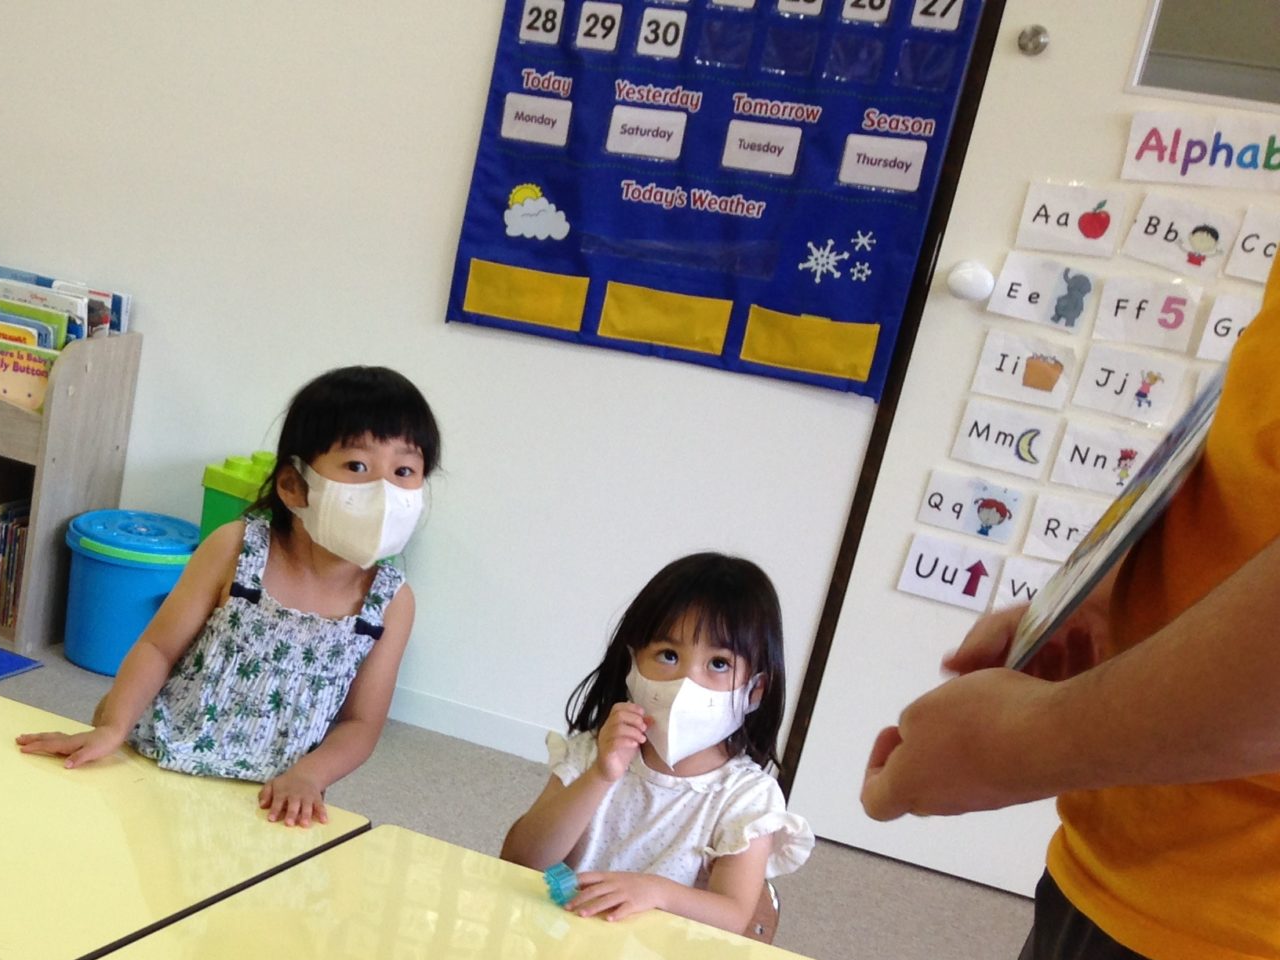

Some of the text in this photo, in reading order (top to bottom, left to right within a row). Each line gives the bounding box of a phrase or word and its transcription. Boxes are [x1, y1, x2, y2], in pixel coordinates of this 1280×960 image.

[526, 6, 680, 46] 28 29 30
[522, 68, 572, 97] Today
[615, 79, 703, 112] Yesterday
[514, 110, 557, 128] Monday
[733, 92, 822, 123] Tomorrow
[620, 123, 673, 142] Saturday
[862, 108, 935, 136] Season
[737, 138, 784, 157] Tuesday
[855, 152, 912, 174] Thursday
[621, 180, 766, 218] Today's Weather
[1157, 296, 1188, 330] 5
[12, 360, 48, 378] Button
